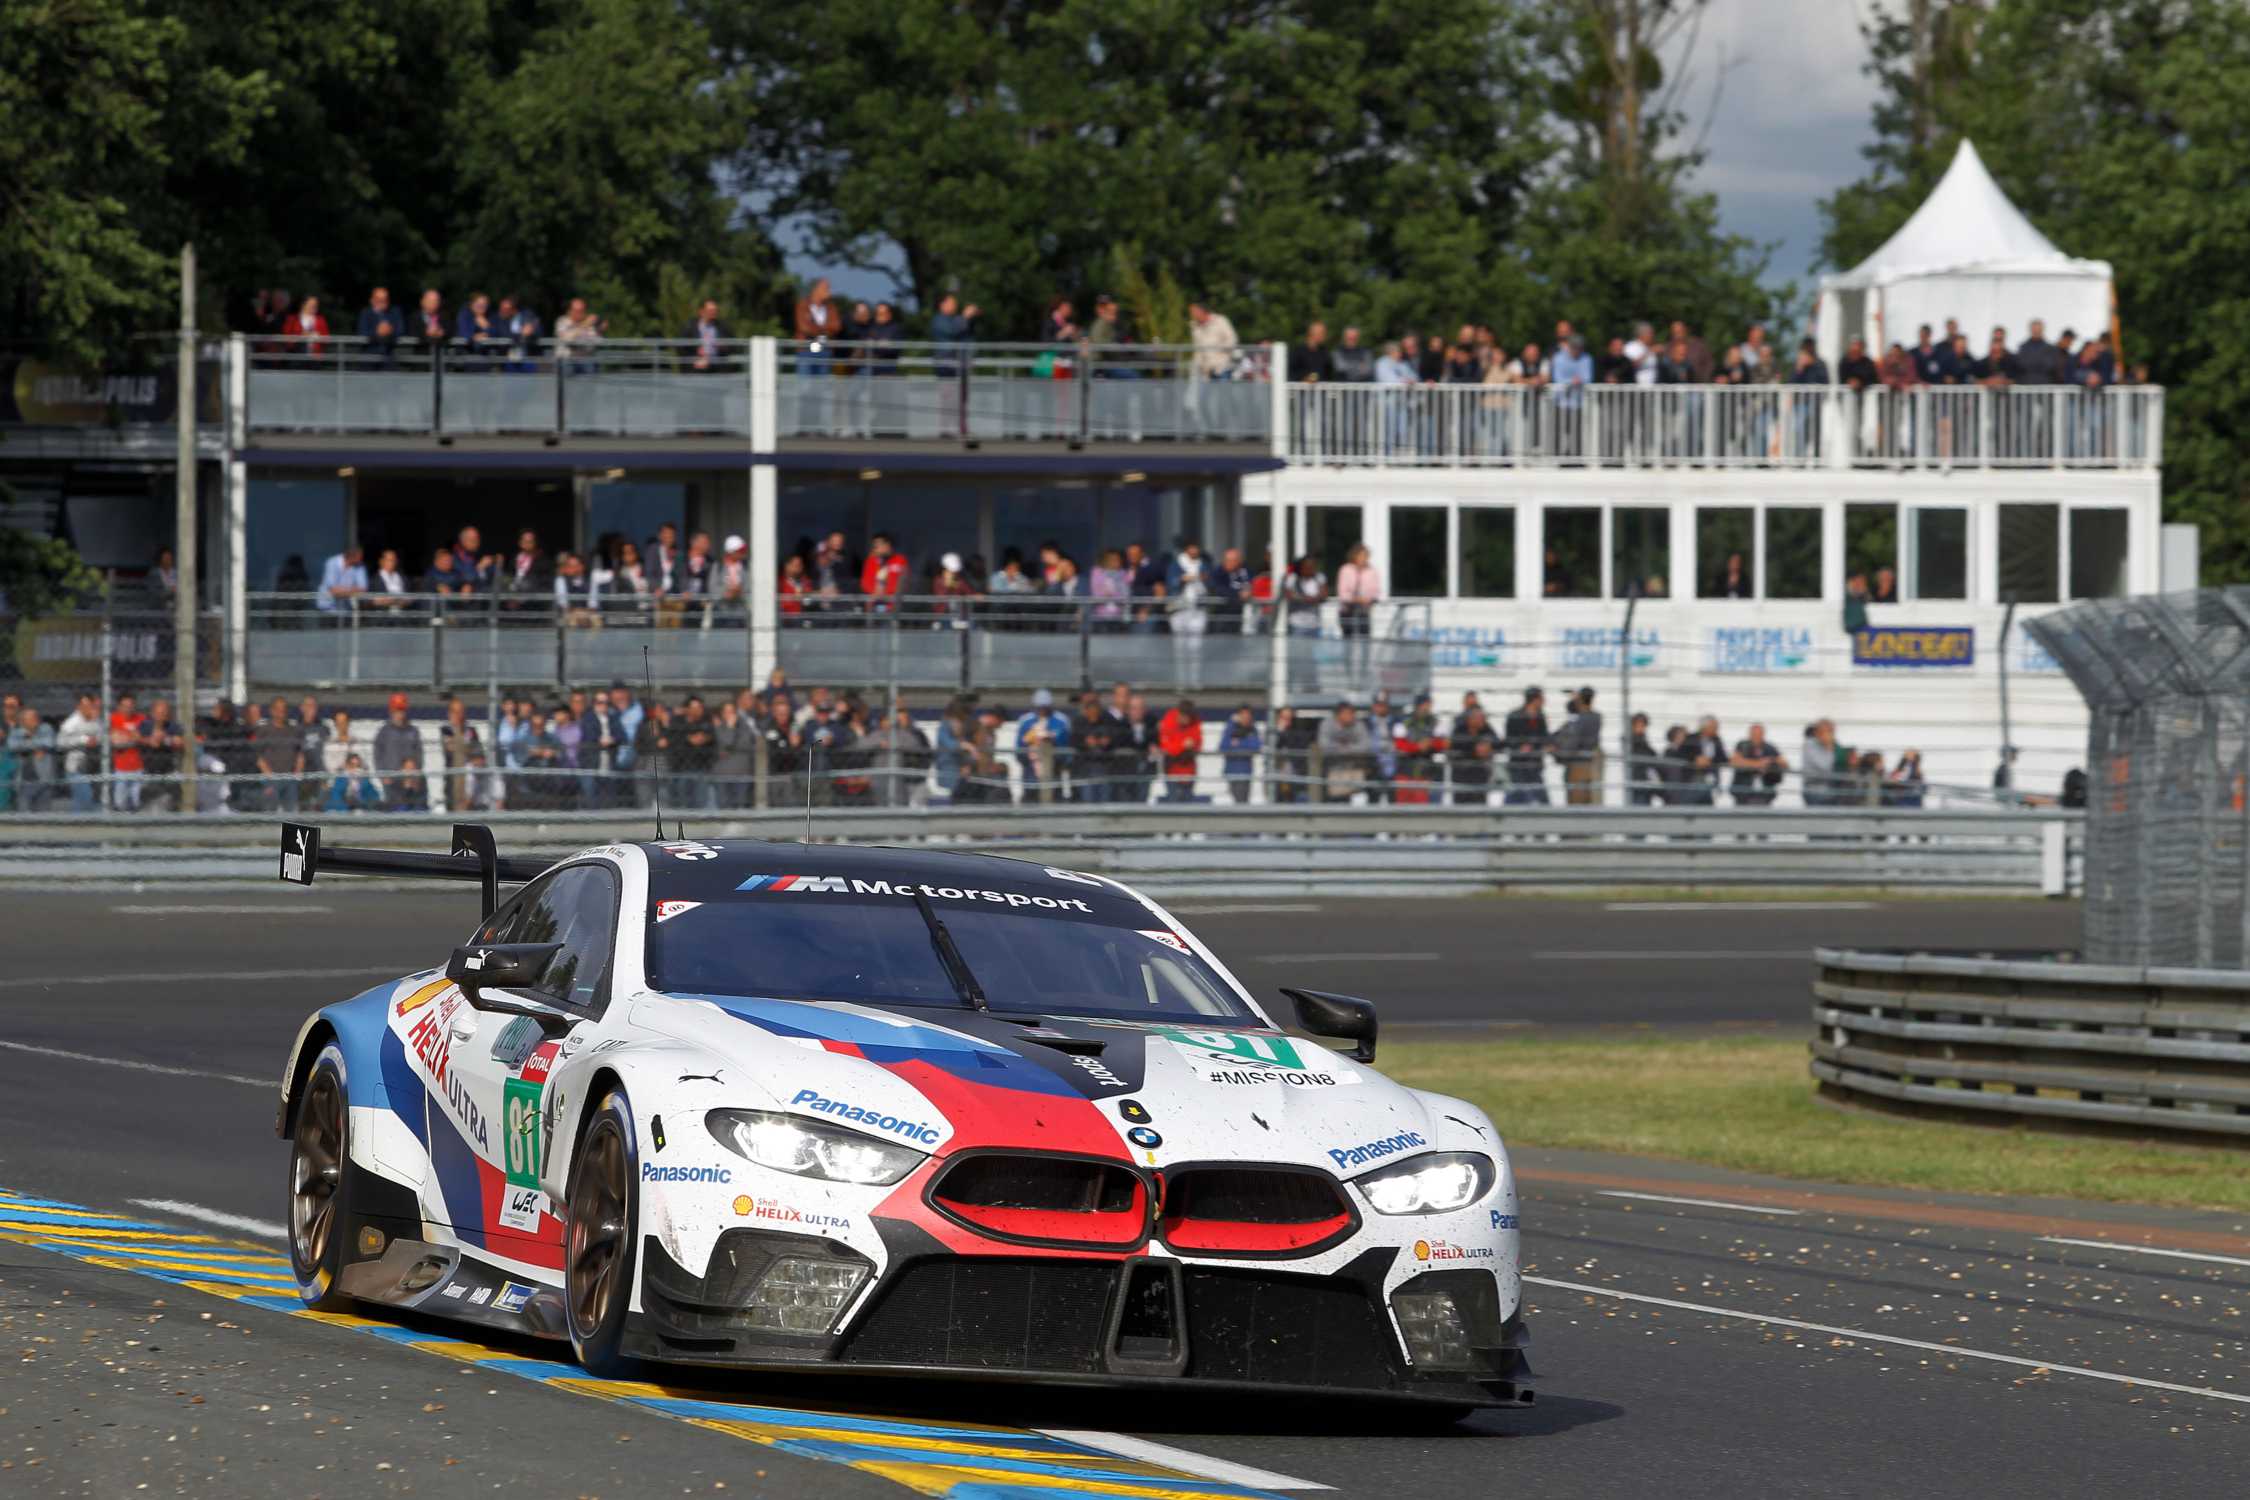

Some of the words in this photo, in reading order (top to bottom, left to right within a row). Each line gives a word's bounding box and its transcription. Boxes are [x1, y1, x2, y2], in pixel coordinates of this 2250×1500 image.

[850, 878, 1094, 913] Motorsport
[527, 1052, 550, 1072] TOTAL
[1069, 1054, 1128, 1087] sport
[449, 1070, 488, 1153] ULTRA
[790, 1089, 942, 1145] Panasonic
[509, 1096, 535, 1176] 81
[1327, 1130, 1427, 1169] Panasonic
[641, 1162, 732, 1184] Panasonic
[755, 1206, 803, 1222] HELIX
[805, 1214, 850, 1229] ULTRA
[1432, 1246, 1465, 1260] HELIX
[1466, 1248, 1494, 1258] ULTRA
